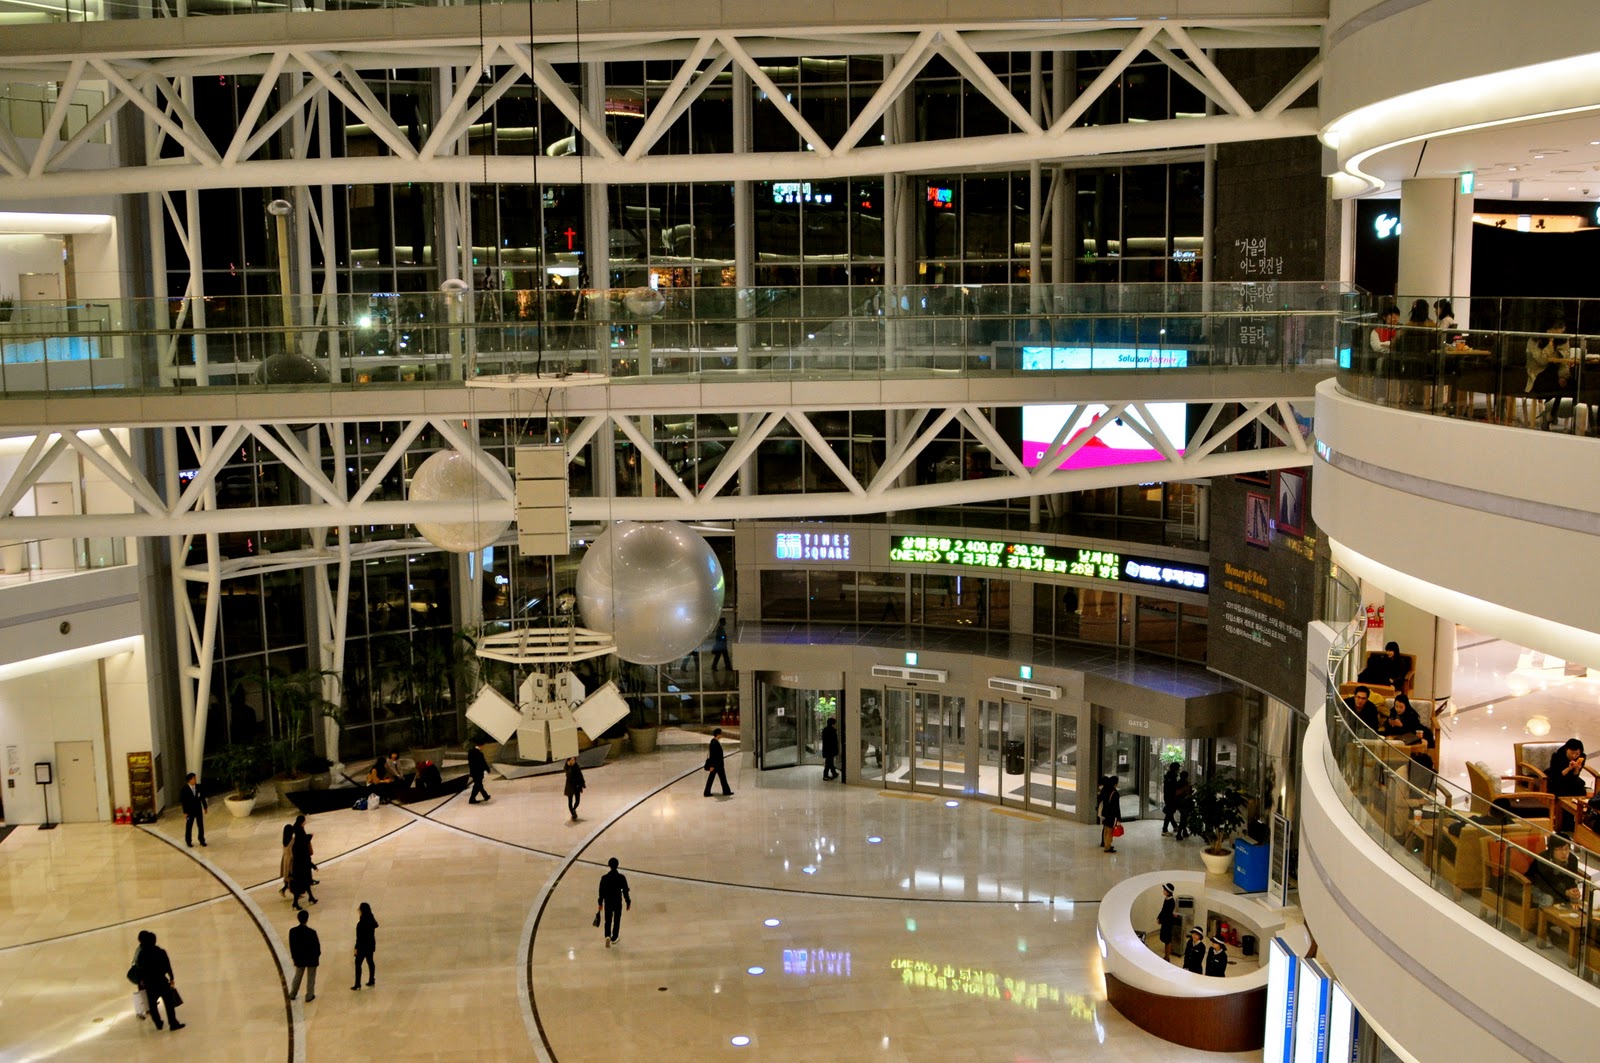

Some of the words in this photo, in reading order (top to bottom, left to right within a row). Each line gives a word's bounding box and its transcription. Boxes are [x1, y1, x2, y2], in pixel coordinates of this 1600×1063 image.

[1240, 257, 1256, 274] 어느
[1259, 257, 1274, 274] 멋진
[1276, 256, 1284, 274] 날
[804, 533, 849, 546] TIMES
[804, 546, 850, 560] SQUARE
[890, 548, 942, 562] <NEWS>
[1128, 720, 1143, 728] GATE
[1143, 720, 1149, 729] 3
